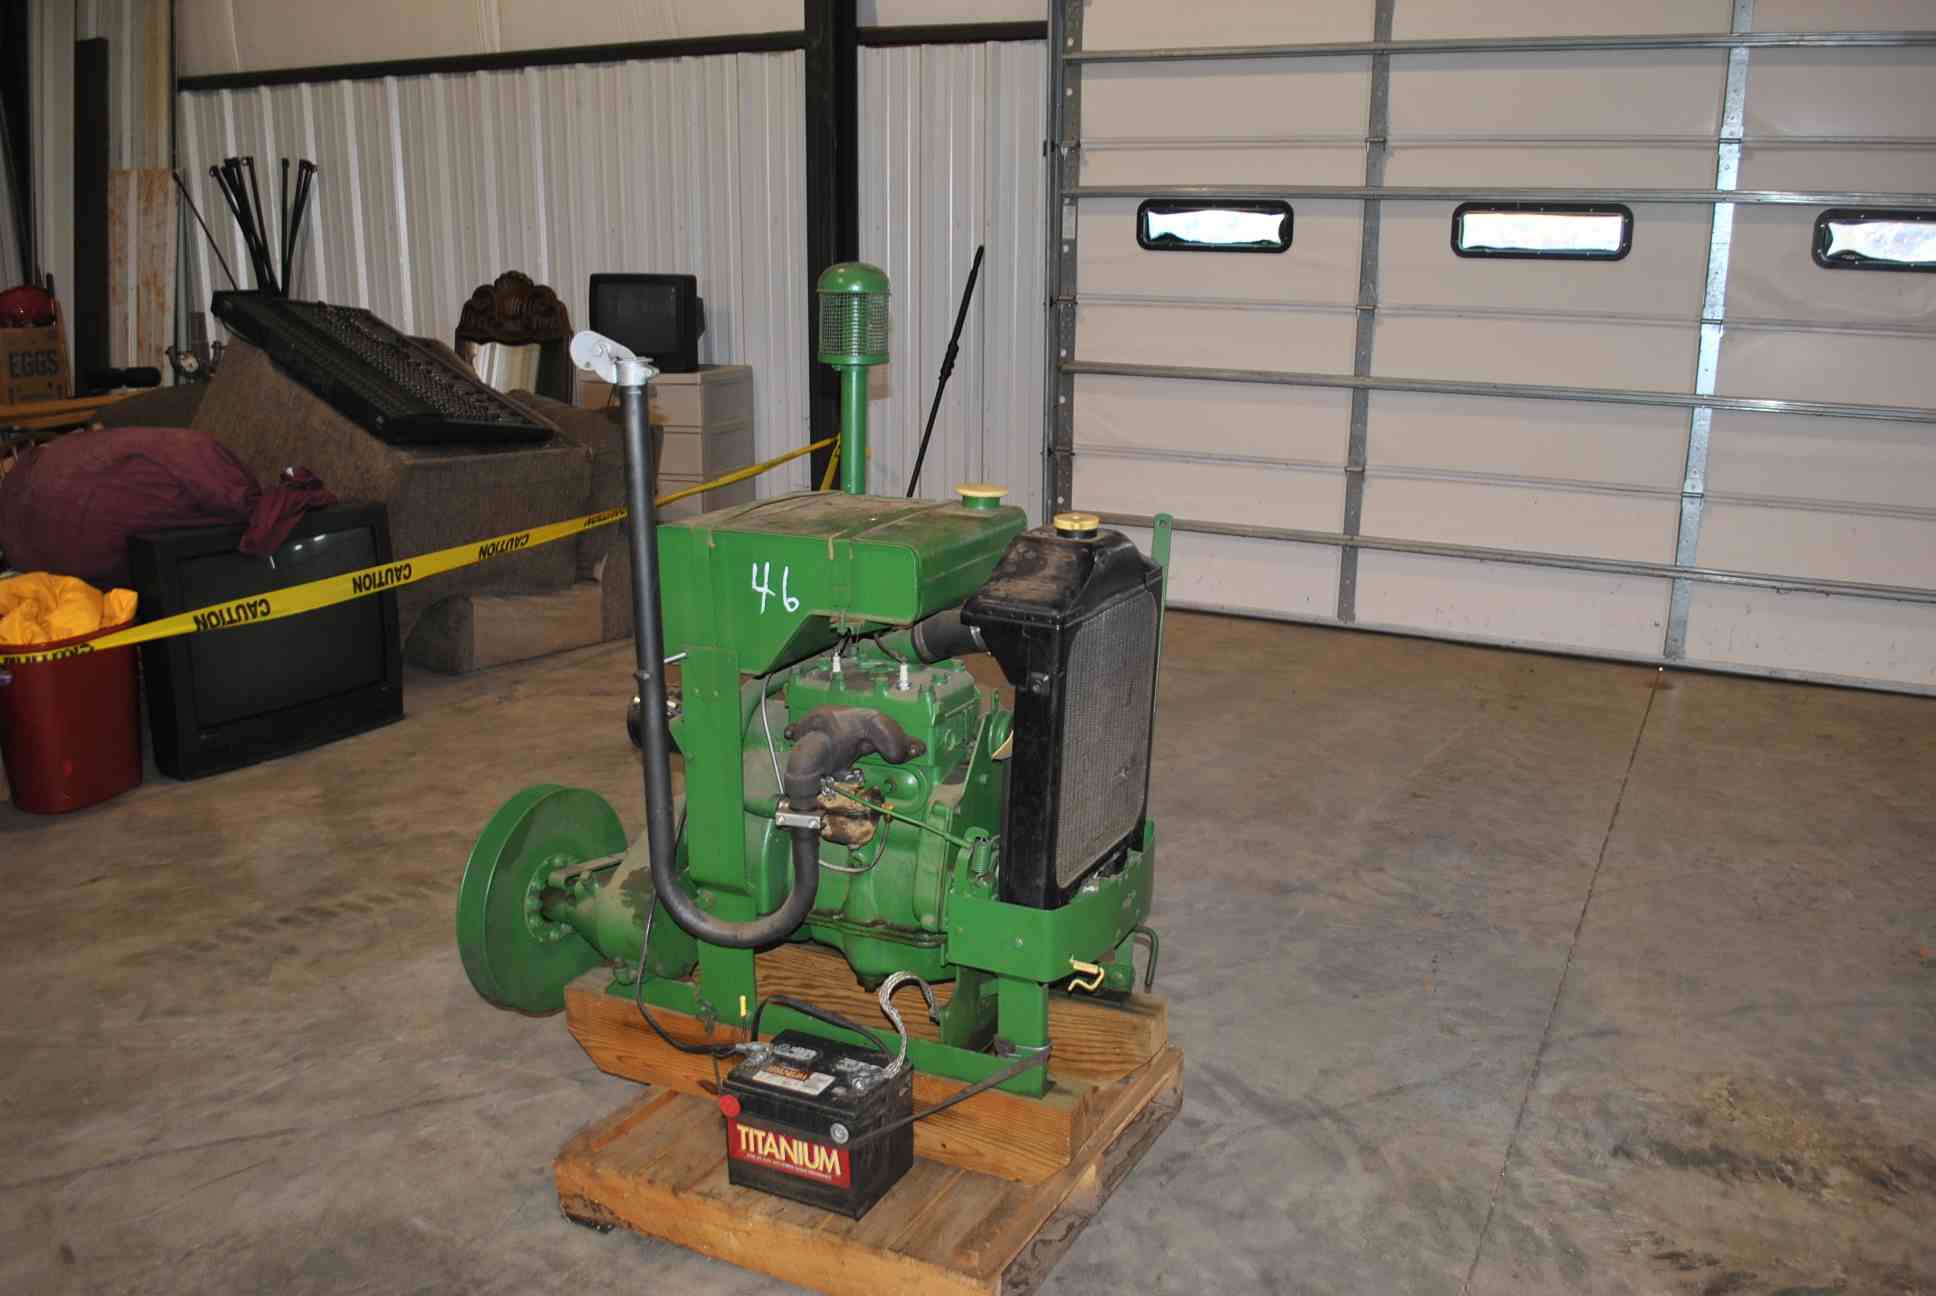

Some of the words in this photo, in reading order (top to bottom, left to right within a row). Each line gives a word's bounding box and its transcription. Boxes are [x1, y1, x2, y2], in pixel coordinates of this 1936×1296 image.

[8, 351, 57, 377] EGGS
[479, 534, 530, 559] CAUTION
[352, 563, 413, 594] CAUTION
[752, 561, 800, 615] 46
[193, 598, 272, 632] CAUTION
[737, 1123, 841, 1176] TITANIUM
